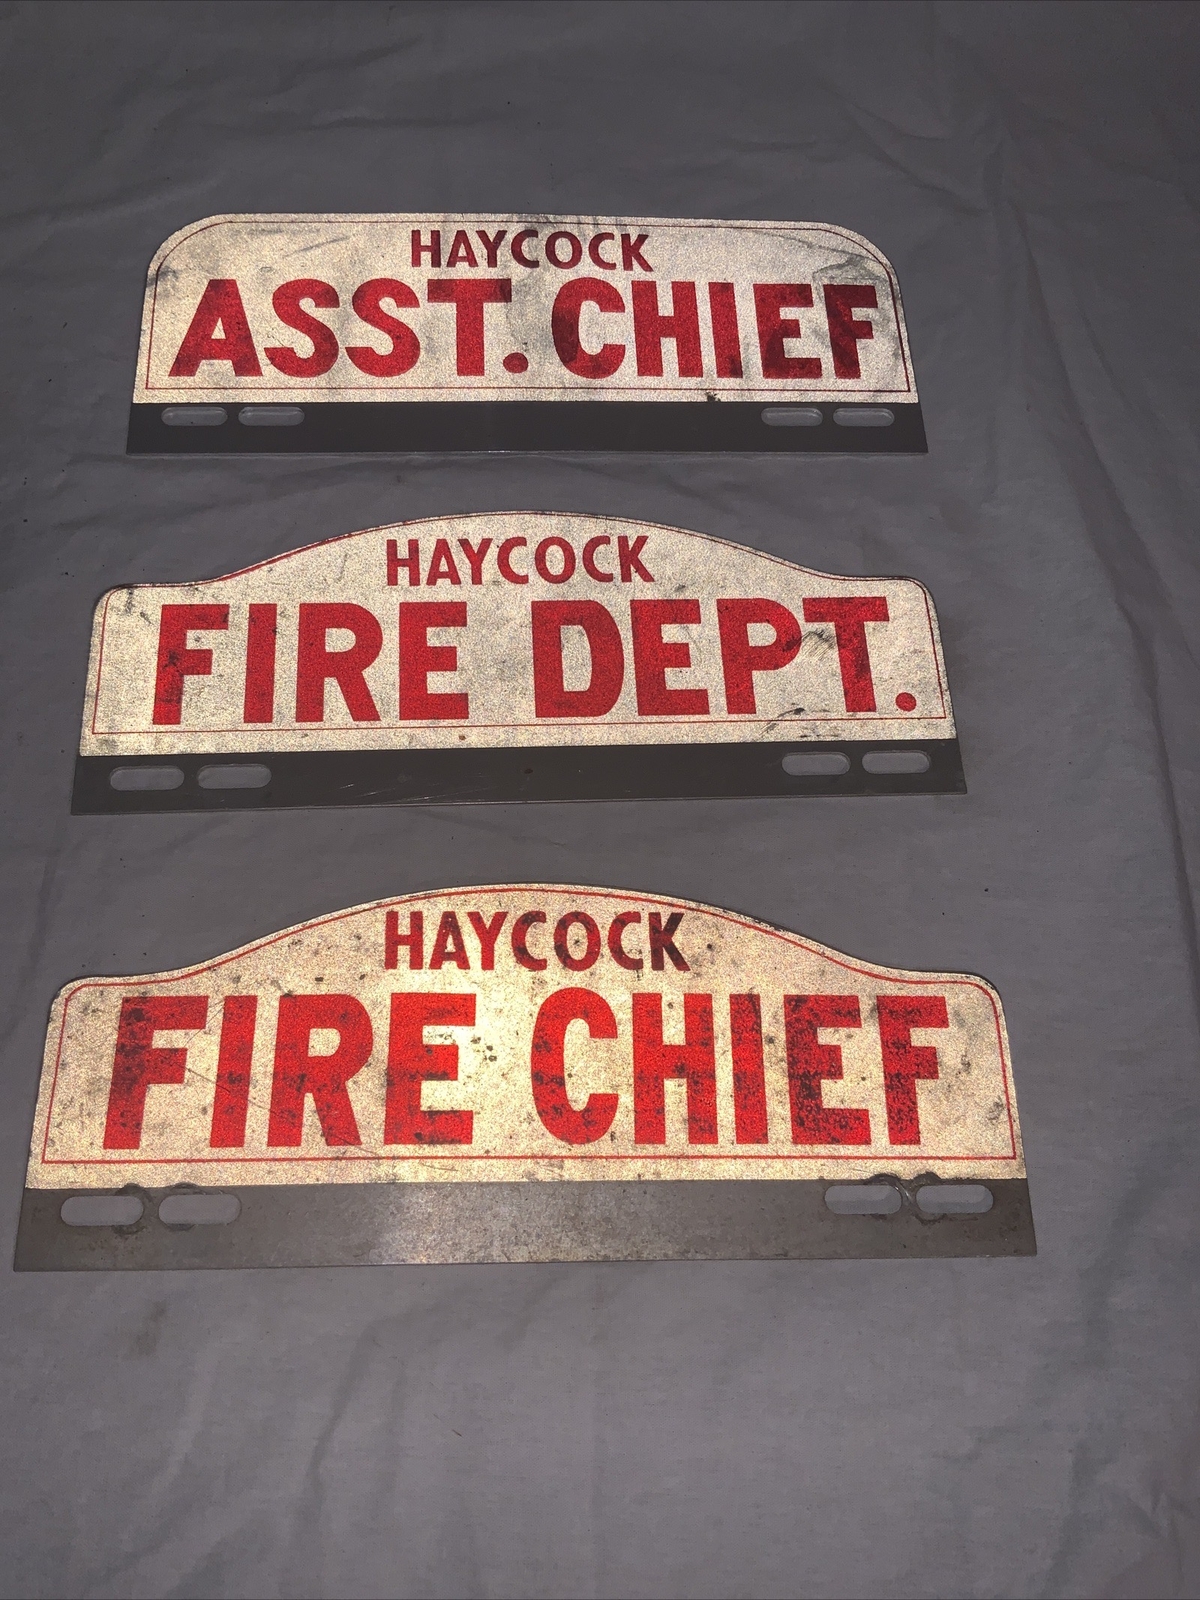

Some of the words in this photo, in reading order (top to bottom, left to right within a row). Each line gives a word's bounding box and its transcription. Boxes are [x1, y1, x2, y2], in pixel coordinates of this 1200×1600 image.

[411, 228, 653, 272] HAYCOCK
[168, 276, 528, 379] ASST.
[552, 276, 879, 380] CHIEF
[386, 533, 655, 587] HAYCOCK
[152, 600, 470, 726] FIRE
[530, 594, 919, 720] DEPT.
[384, 908, 693, 973] HAYCOCK
[102, 991, 477, 1152] FIRE
[530, 985, 949, 1150] CHIEF
